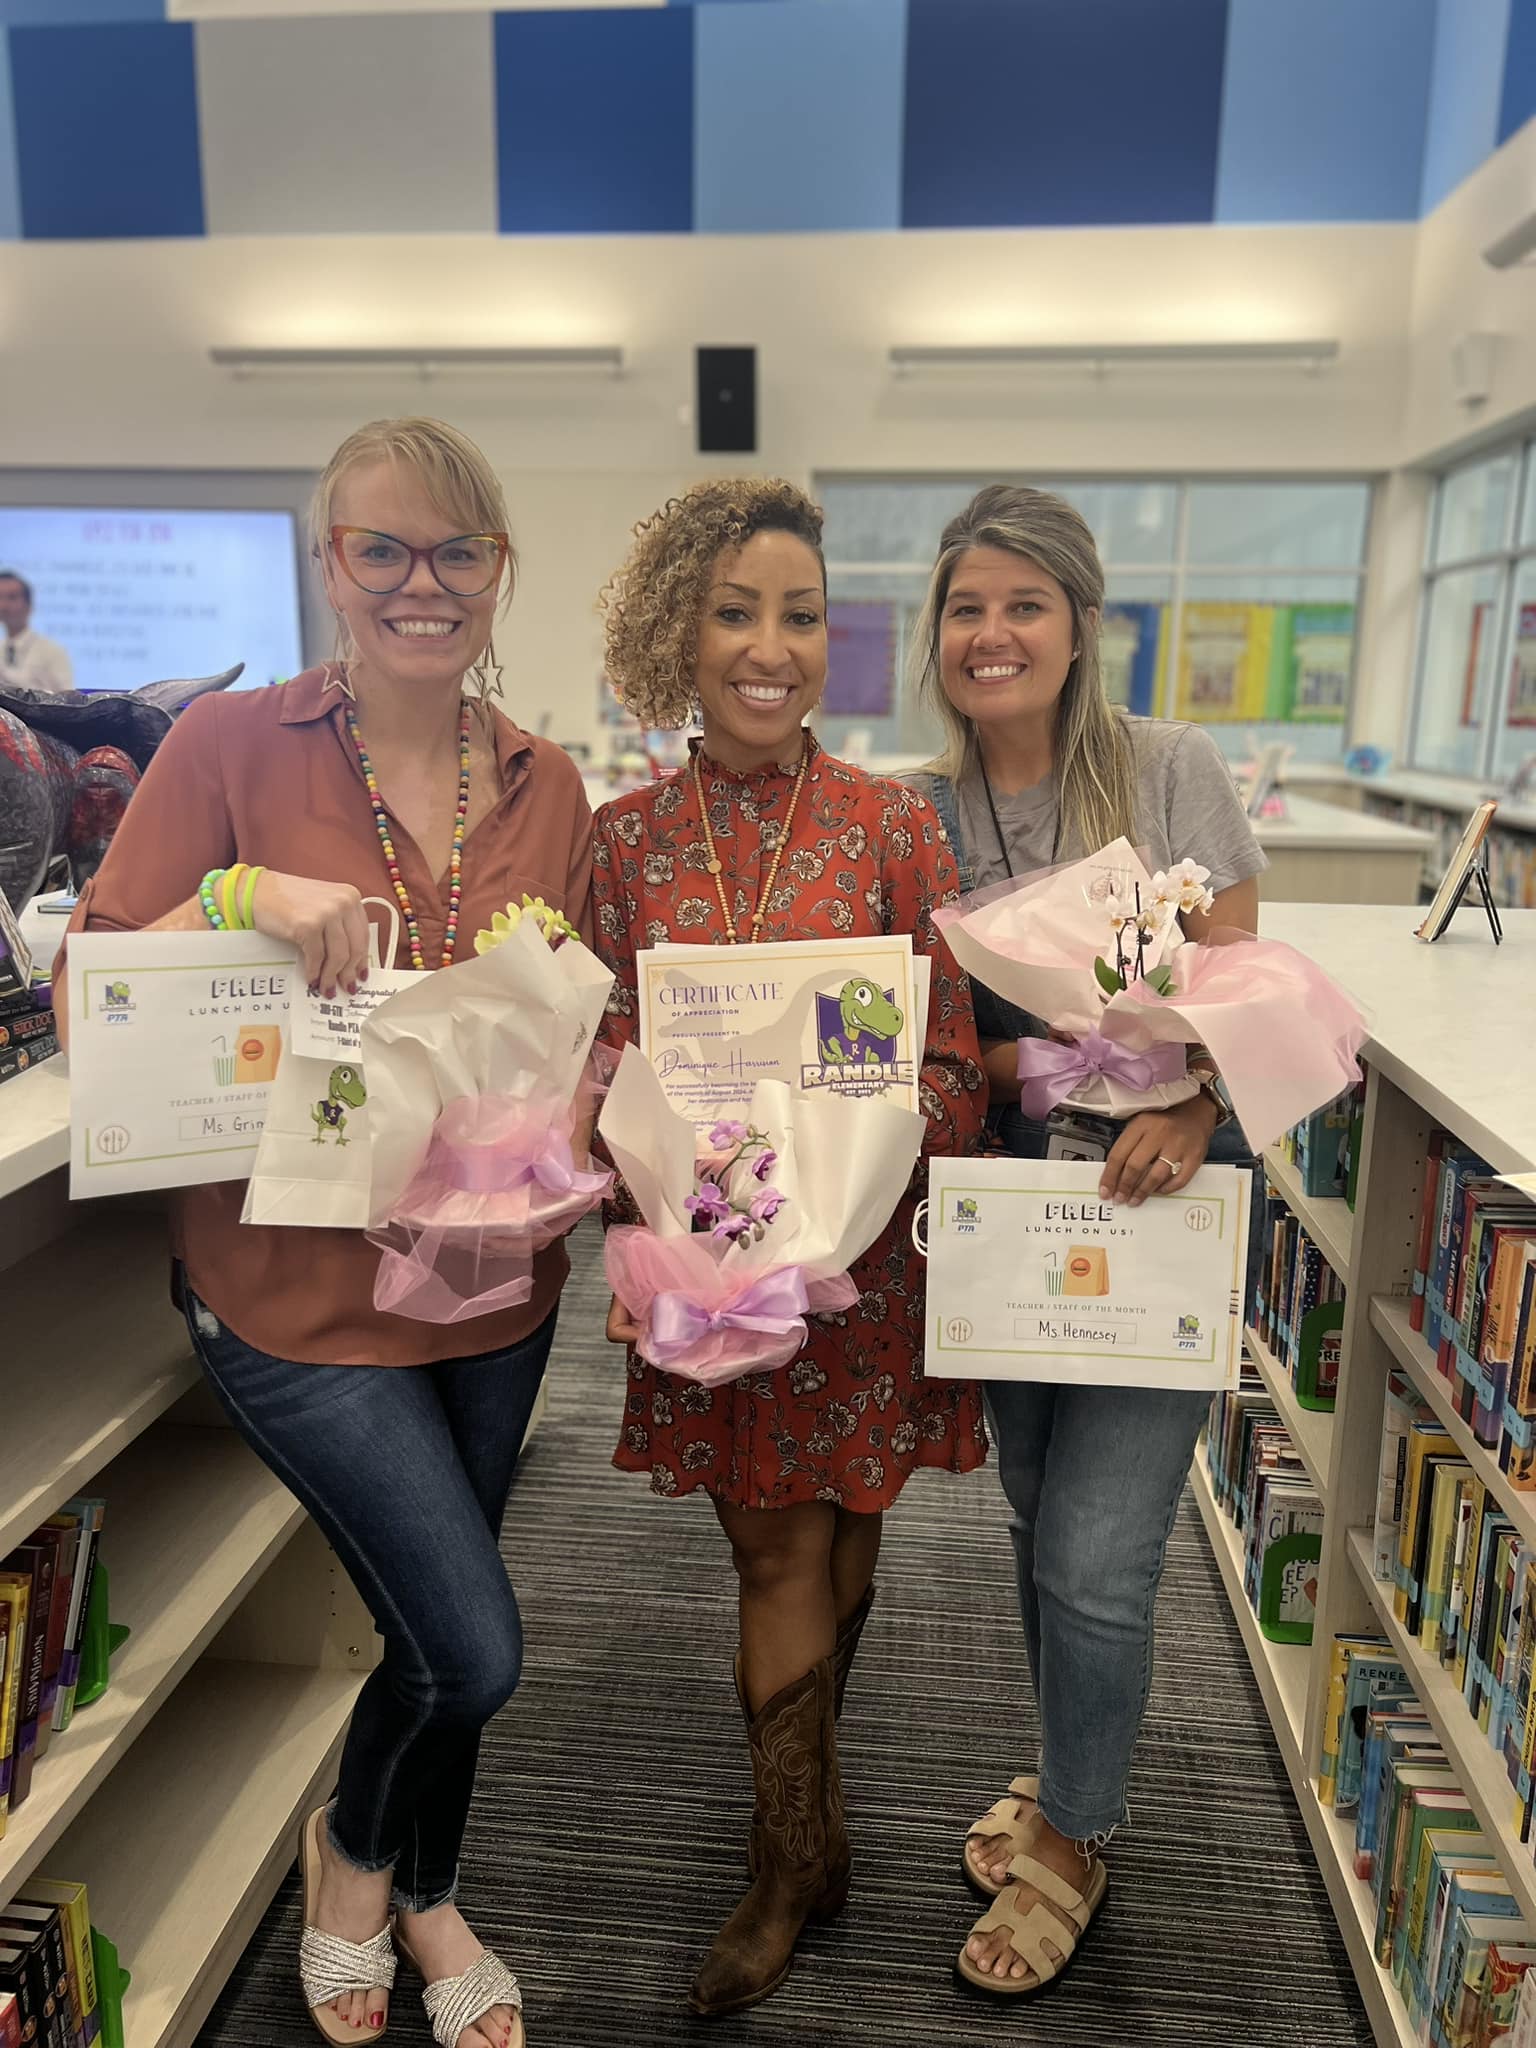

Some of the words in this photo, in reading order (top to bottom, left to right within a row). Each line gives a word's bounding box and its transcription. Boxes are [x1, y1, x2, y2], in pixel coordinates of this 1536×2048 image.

[211, 975, 286, 999] FREE
[355, 986, 397, 999] Congratul
[659, 982, 784, 1005] CERTIFICATE
[189, 1004, 242, 1016] LUNCH
[252, 1003, 272, 1012] ON
[683, 1009, 739, 1017] APPRECIATION
[654, 1049, 720, 1078] Dominique
[801, 1061, 913, 1090] RANDLE
[168, 1096, 214, 1108] TEACHER
[224, 1092, 253, 1103] STAFF
[1045, 1202, 1114, 1221] FREE
[1025, 1226, 1073, 1234] LUNCH
[1082, 1227, 1100, 1235] ON
[1110, 1228, 1134, 1236] US!
[1006, 1302, 1044, 1310] TEACHER
[1053, 1303, 1078, 1312] STAFF
[1081, 1304, 1092, 1312] OF
[1096, 1305, 1112, 1313] THE
[1115, 1306, 1147, 1316] MONTH
[1063, 1321, 1117, 1345] Hennesey
